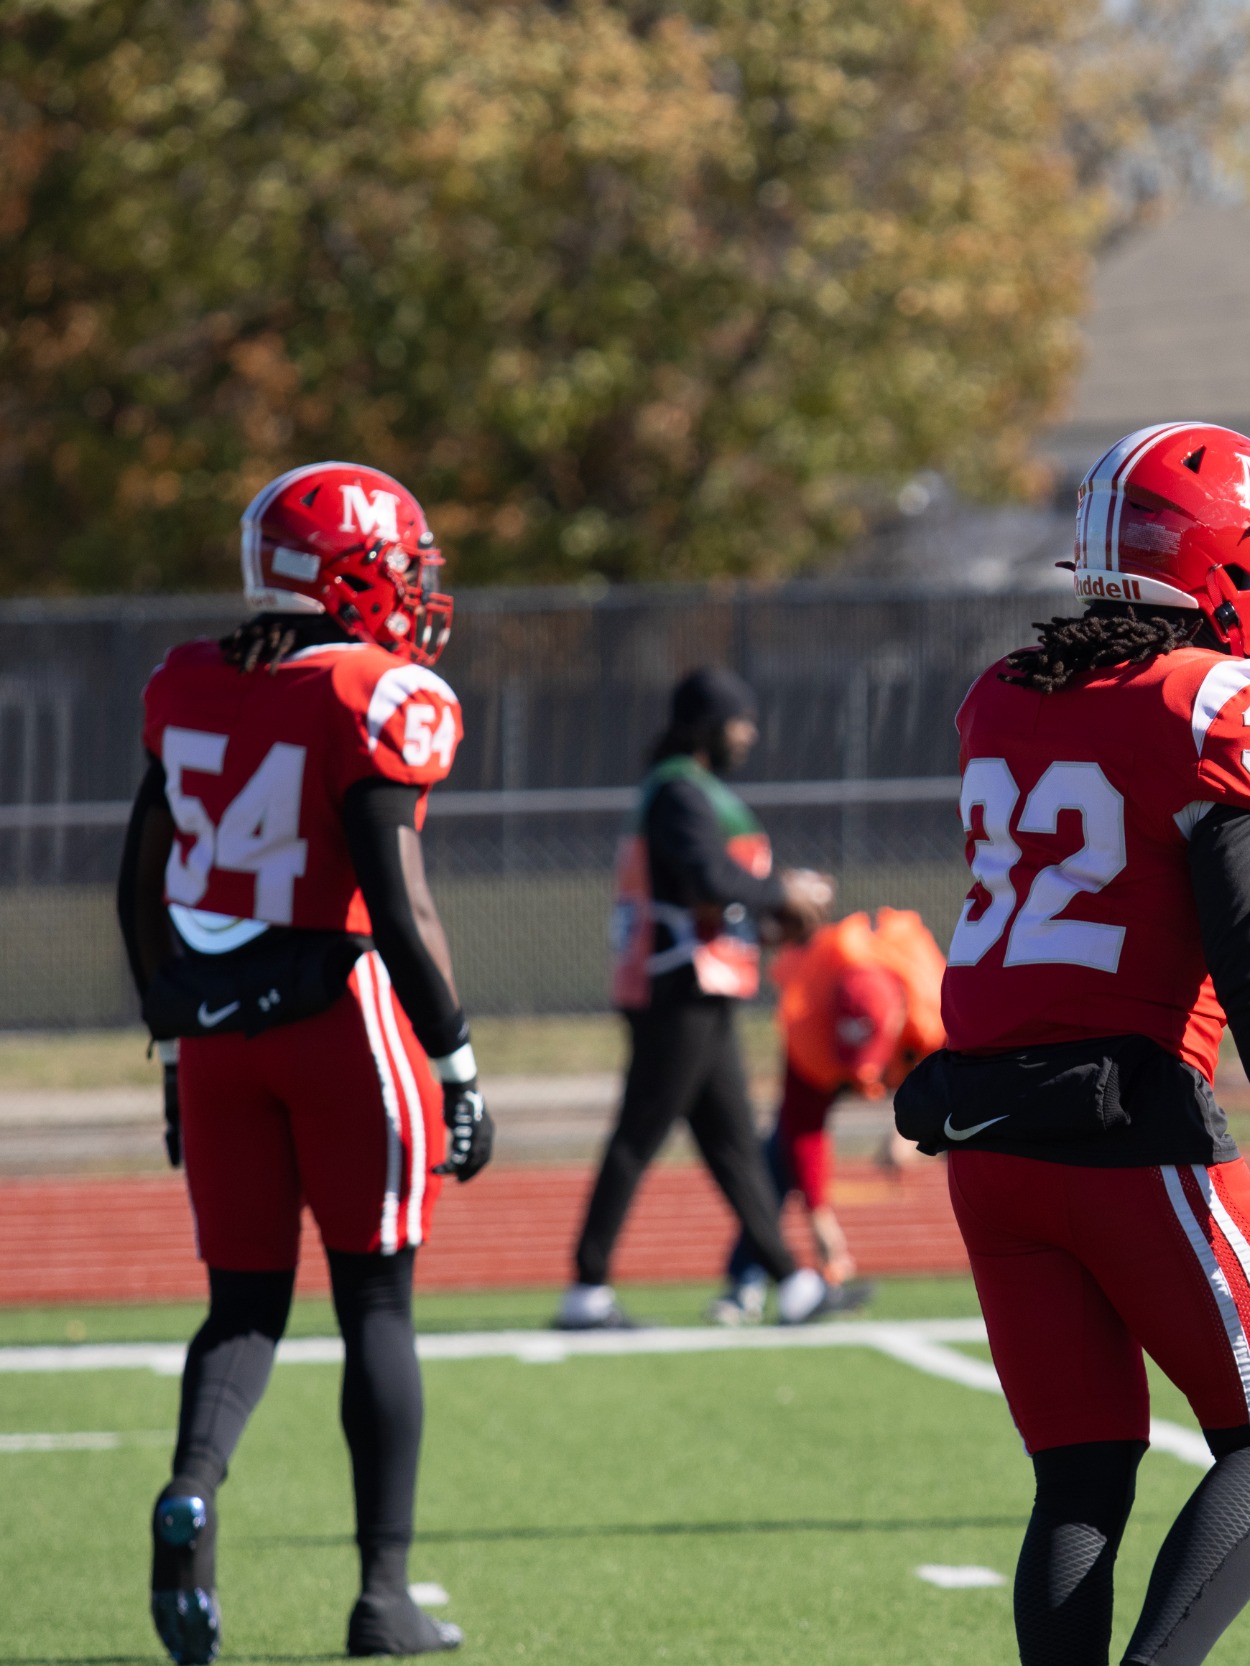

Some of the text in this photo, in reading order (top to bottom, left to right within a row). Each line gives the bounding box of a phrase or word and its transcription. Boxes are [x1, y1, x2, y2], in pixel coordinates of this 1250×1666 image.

[339, 485, 401, 542] M
[403, 703, 456, 768] 54
[162, 726, 308, 925] 54
[947, 757, 1127, 974] 32
